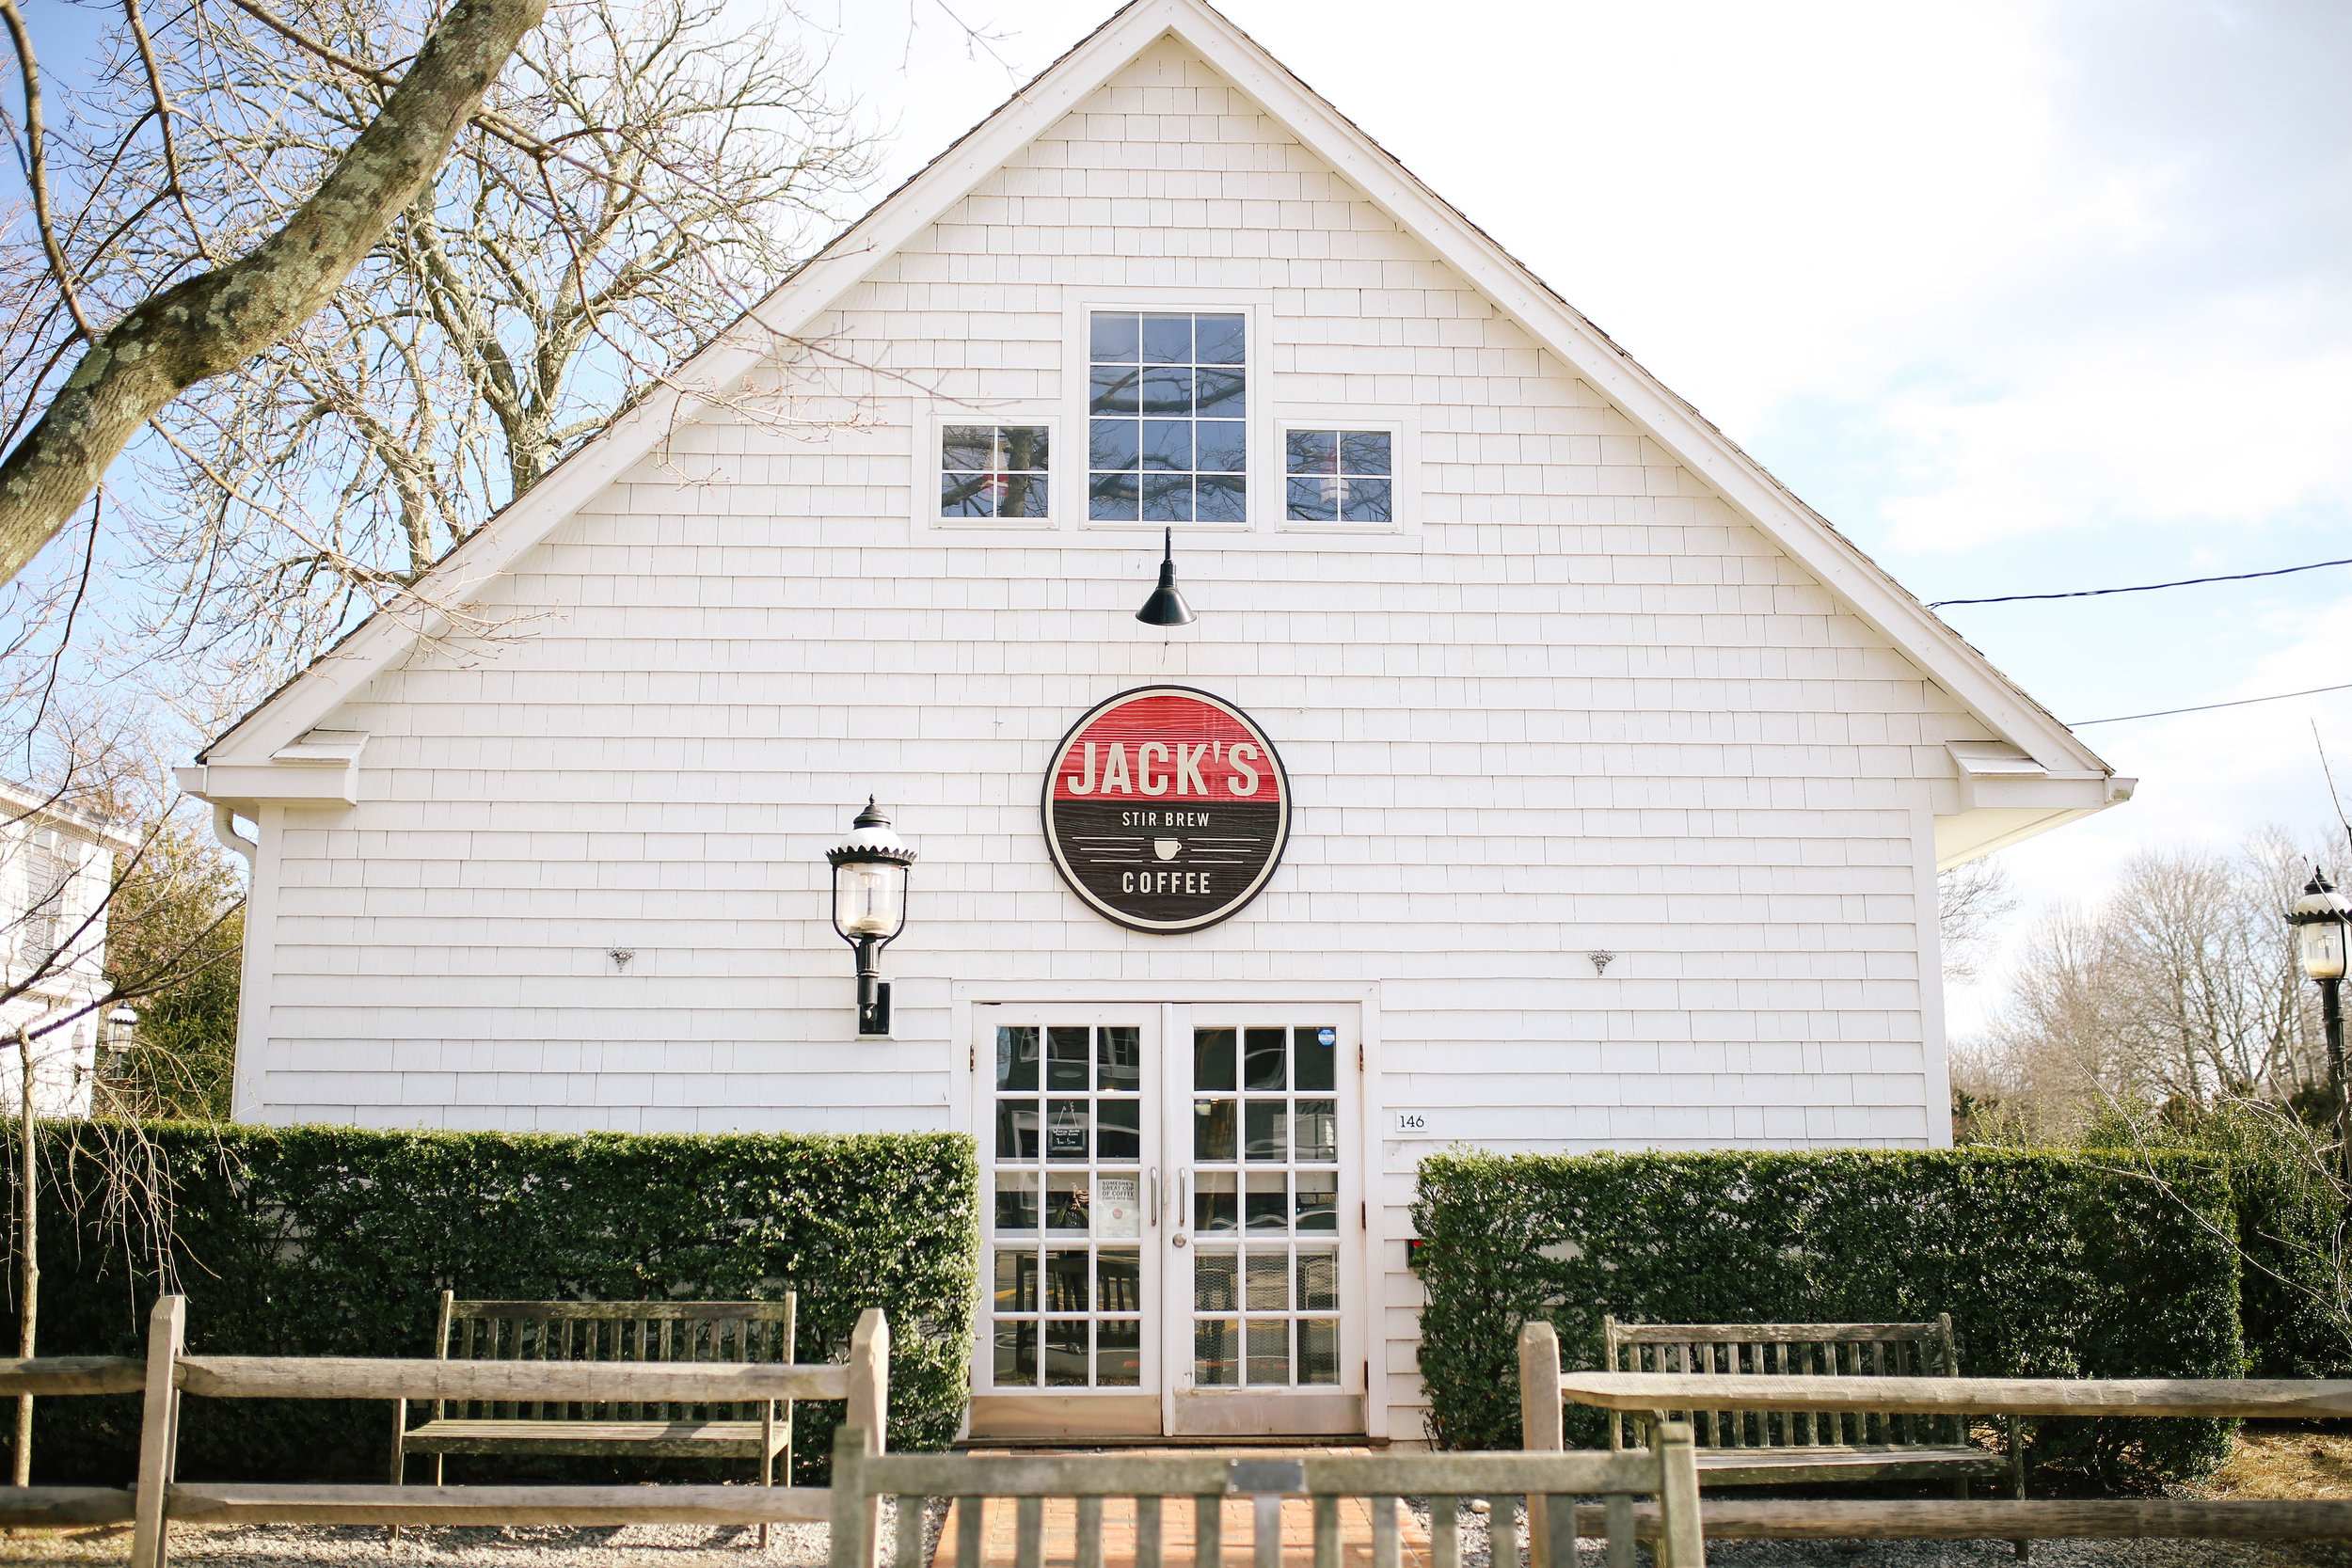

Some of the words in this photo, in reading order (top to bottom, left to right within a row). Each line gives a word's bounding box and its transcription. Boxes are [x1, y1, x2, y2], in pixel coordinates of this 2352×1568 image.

[1067, 741, 1259, 797] JACK'S
[1122, 812, 1157, 827] STIR
[1165, 813, 1210, 827] BREW
[1122, 871, 1211, 894] COFFEE
[1400, 1115, 1424, 1128] 146
